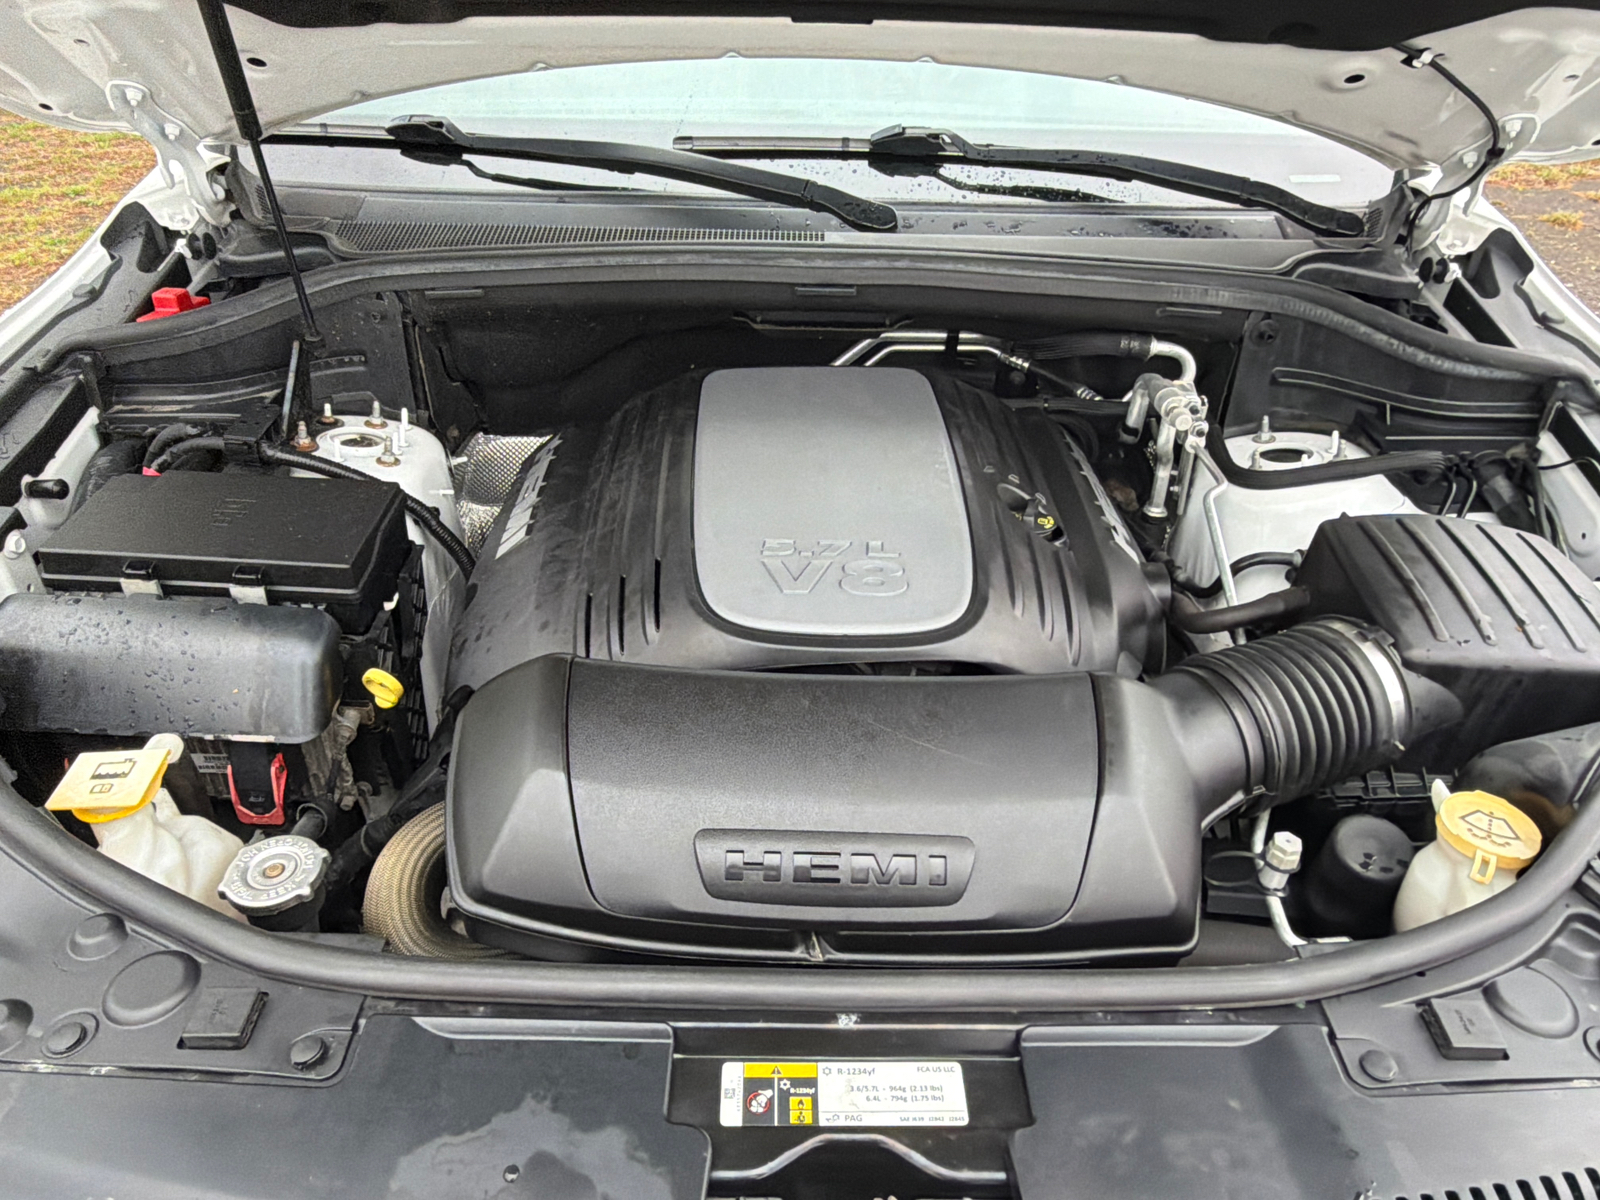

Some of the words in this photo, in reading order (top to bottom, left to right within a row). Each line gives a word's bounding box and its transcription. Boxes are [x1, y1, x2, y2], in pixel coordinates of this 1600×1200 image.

[760, 559, 909, 597] V8
[259, 837, 293, 853] OPEN
[235, 845, 260, 868] HOT
[724, 850, 947, 886] HEMI
[260, 881, 297, 901] KEEP
[837, 1067, 876, 1076] R-1234yf
[849, 1085, 879, 1093] 3.6/5.7L
[888, 1085, 907, 1094] 964g
[909, 1085, 928, 1093] (2.13
[929, 1084, 943, 1093] lbs)
[890, 1095, 908, 1103] 794g
[910, 1094, 930, 1103] (1.75
[930, 1094, 945, 1103] lbs)
[844, 1114, 863, 1122] PAG
